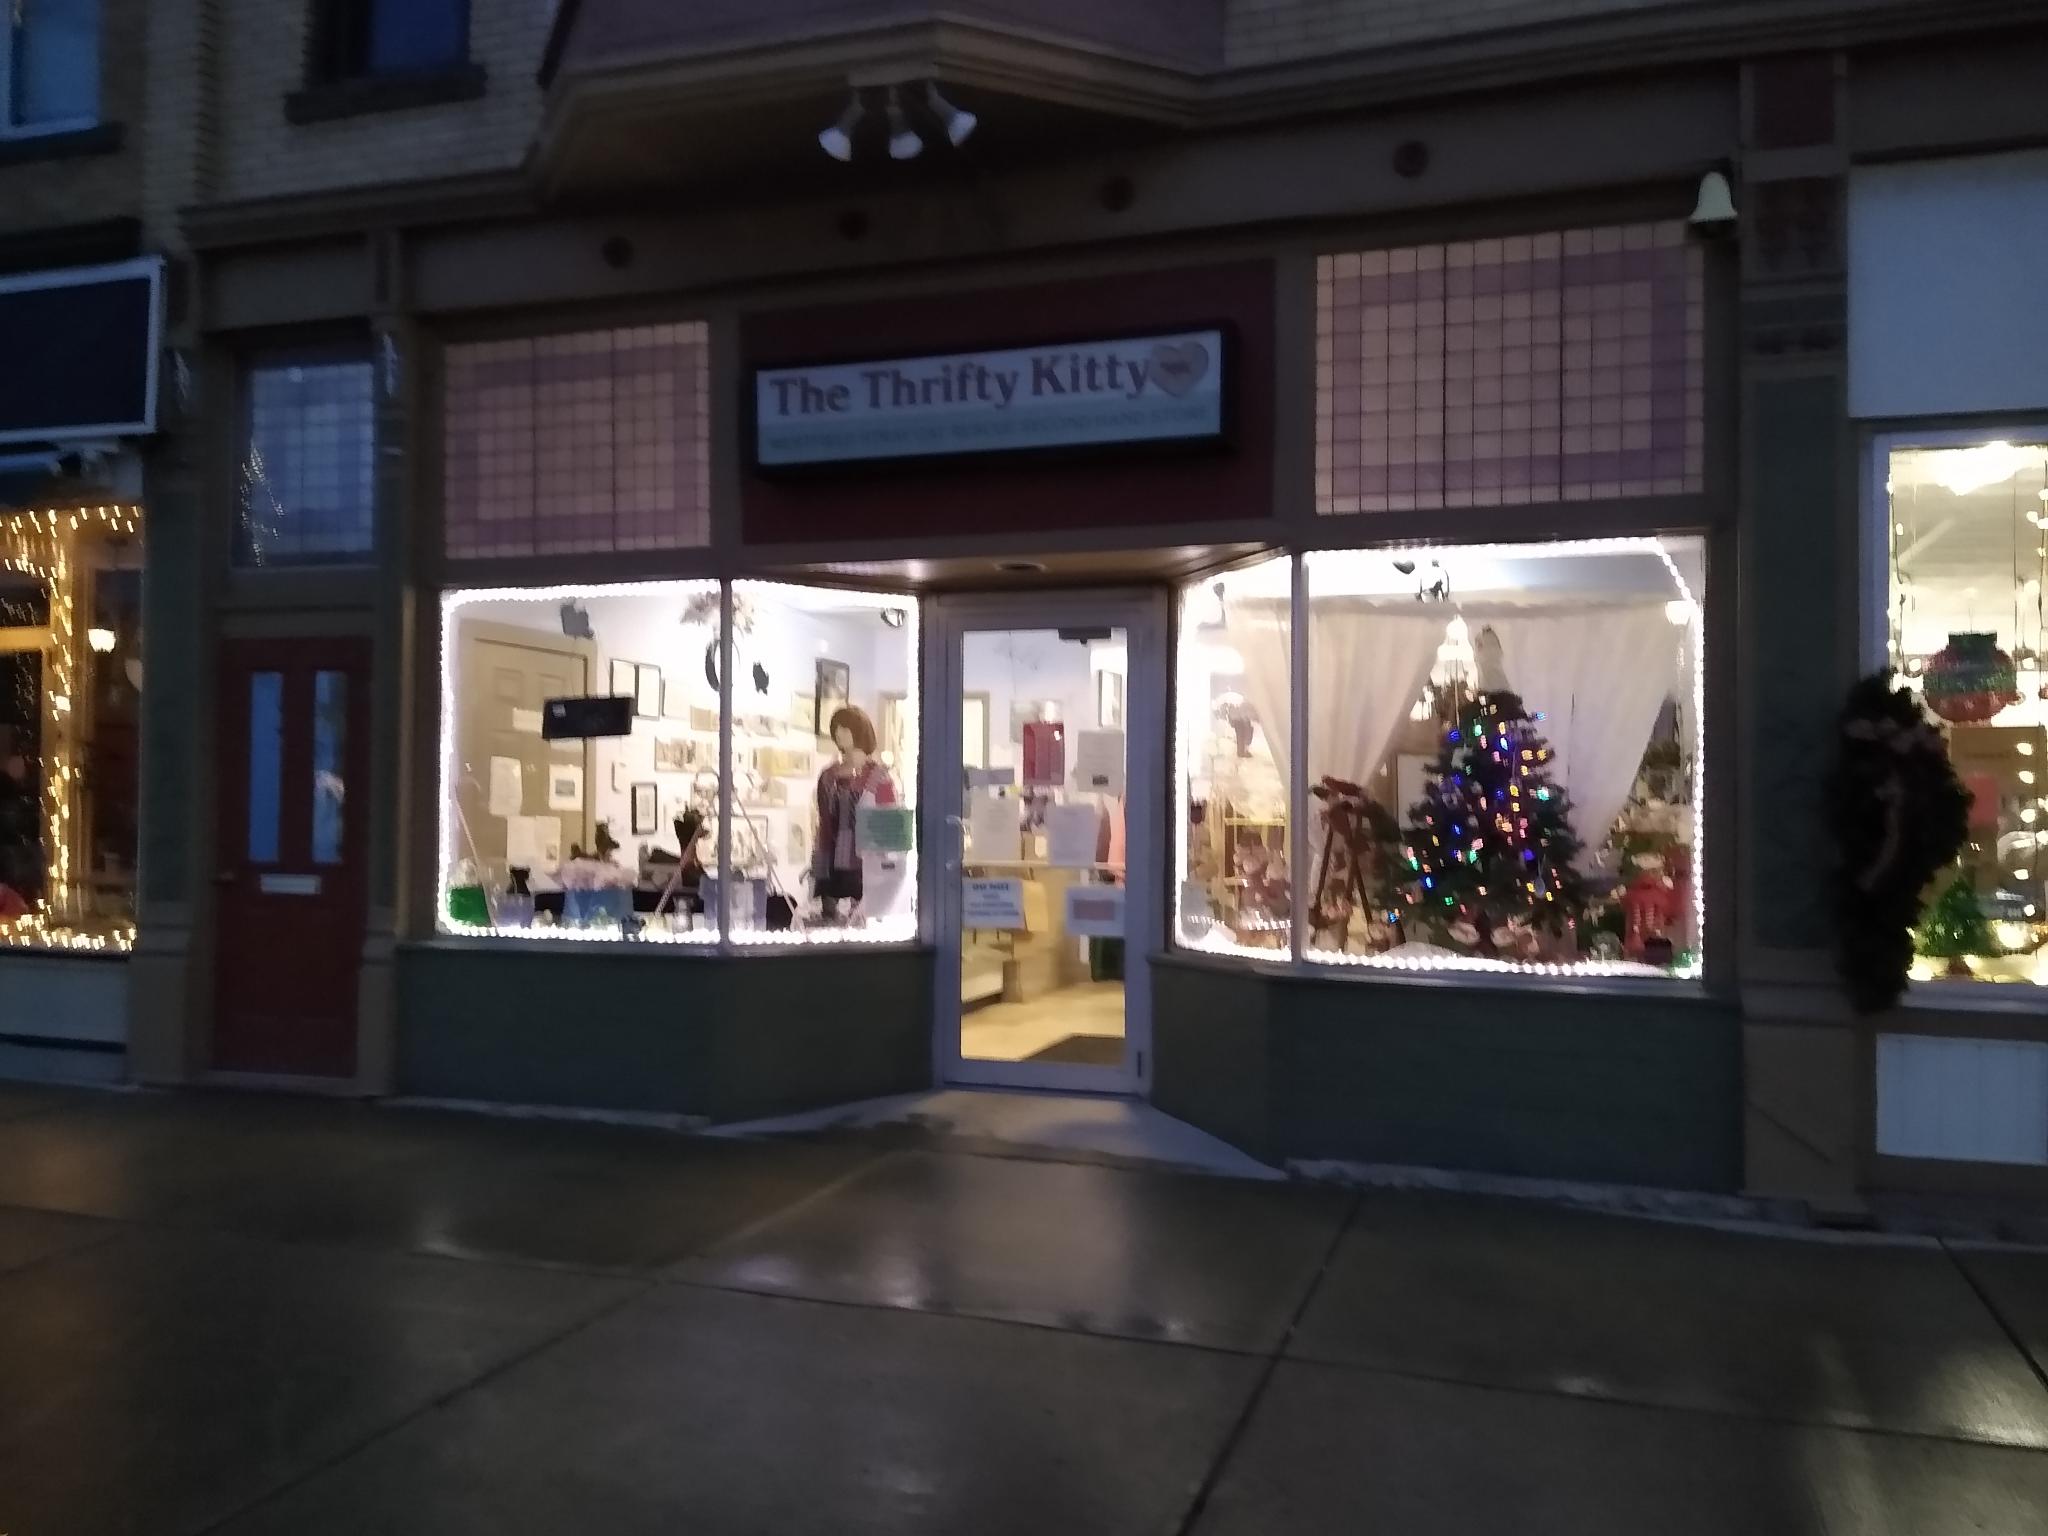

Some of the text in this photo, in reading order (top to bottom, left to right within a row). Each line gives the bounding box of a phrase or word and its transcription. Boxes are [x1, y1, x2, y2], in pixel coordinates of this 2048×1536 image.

[769, 376, 850, 416] The
[861, 362, 1018, 409] Thrifty
[1031, 352, 1151, 399] Kitty
